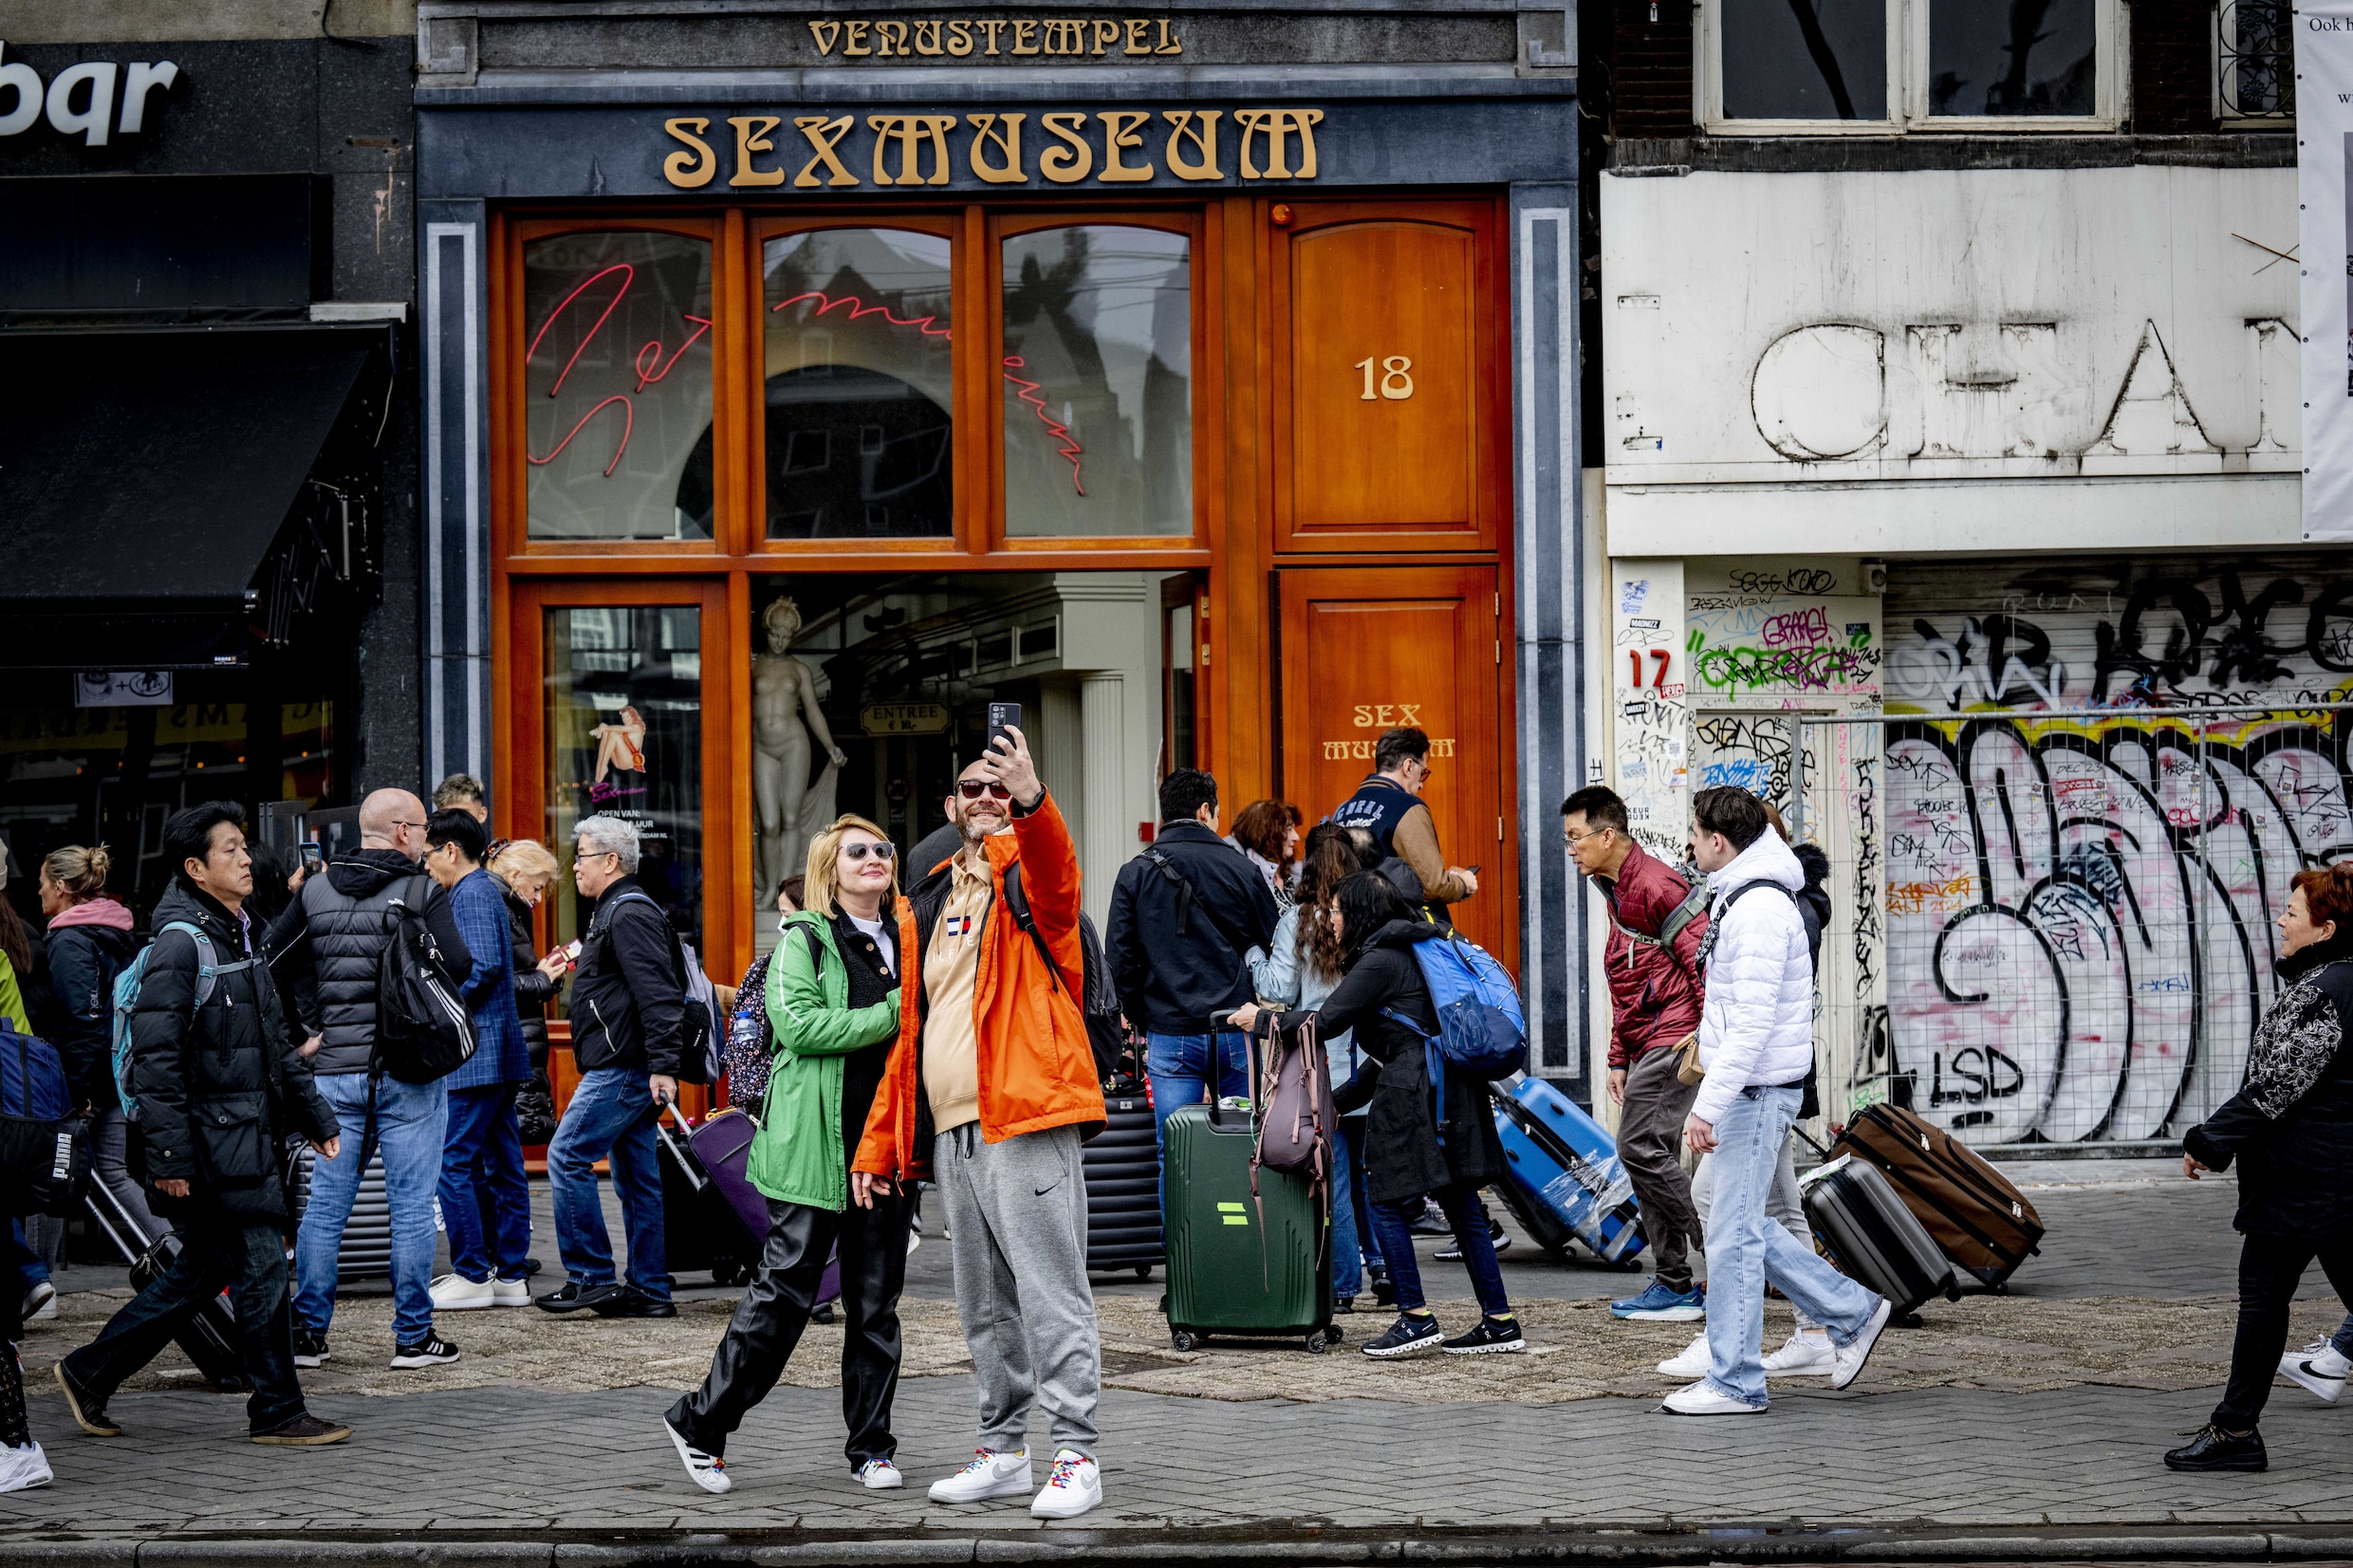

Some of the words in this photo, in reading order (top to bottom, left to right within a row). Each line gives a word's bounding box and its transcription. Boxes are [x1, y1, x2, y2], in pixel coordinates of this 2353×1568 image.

[808, 19, 1183, 57] VENUSTEMPEL
[2309, 17, 2341, 31] Ook
[1354, 356, 1415, 401] 18
[1630, 649, 1671, 688] 17
[873, 706, 939, 719] ENTREE
[1353, 704, 1422, 728] SEX
[1323, 739, 1456, 760] MUM
[1931, 1044, 2025, 1108] LSD
[52, 1133, 72, 1179] PUMA
